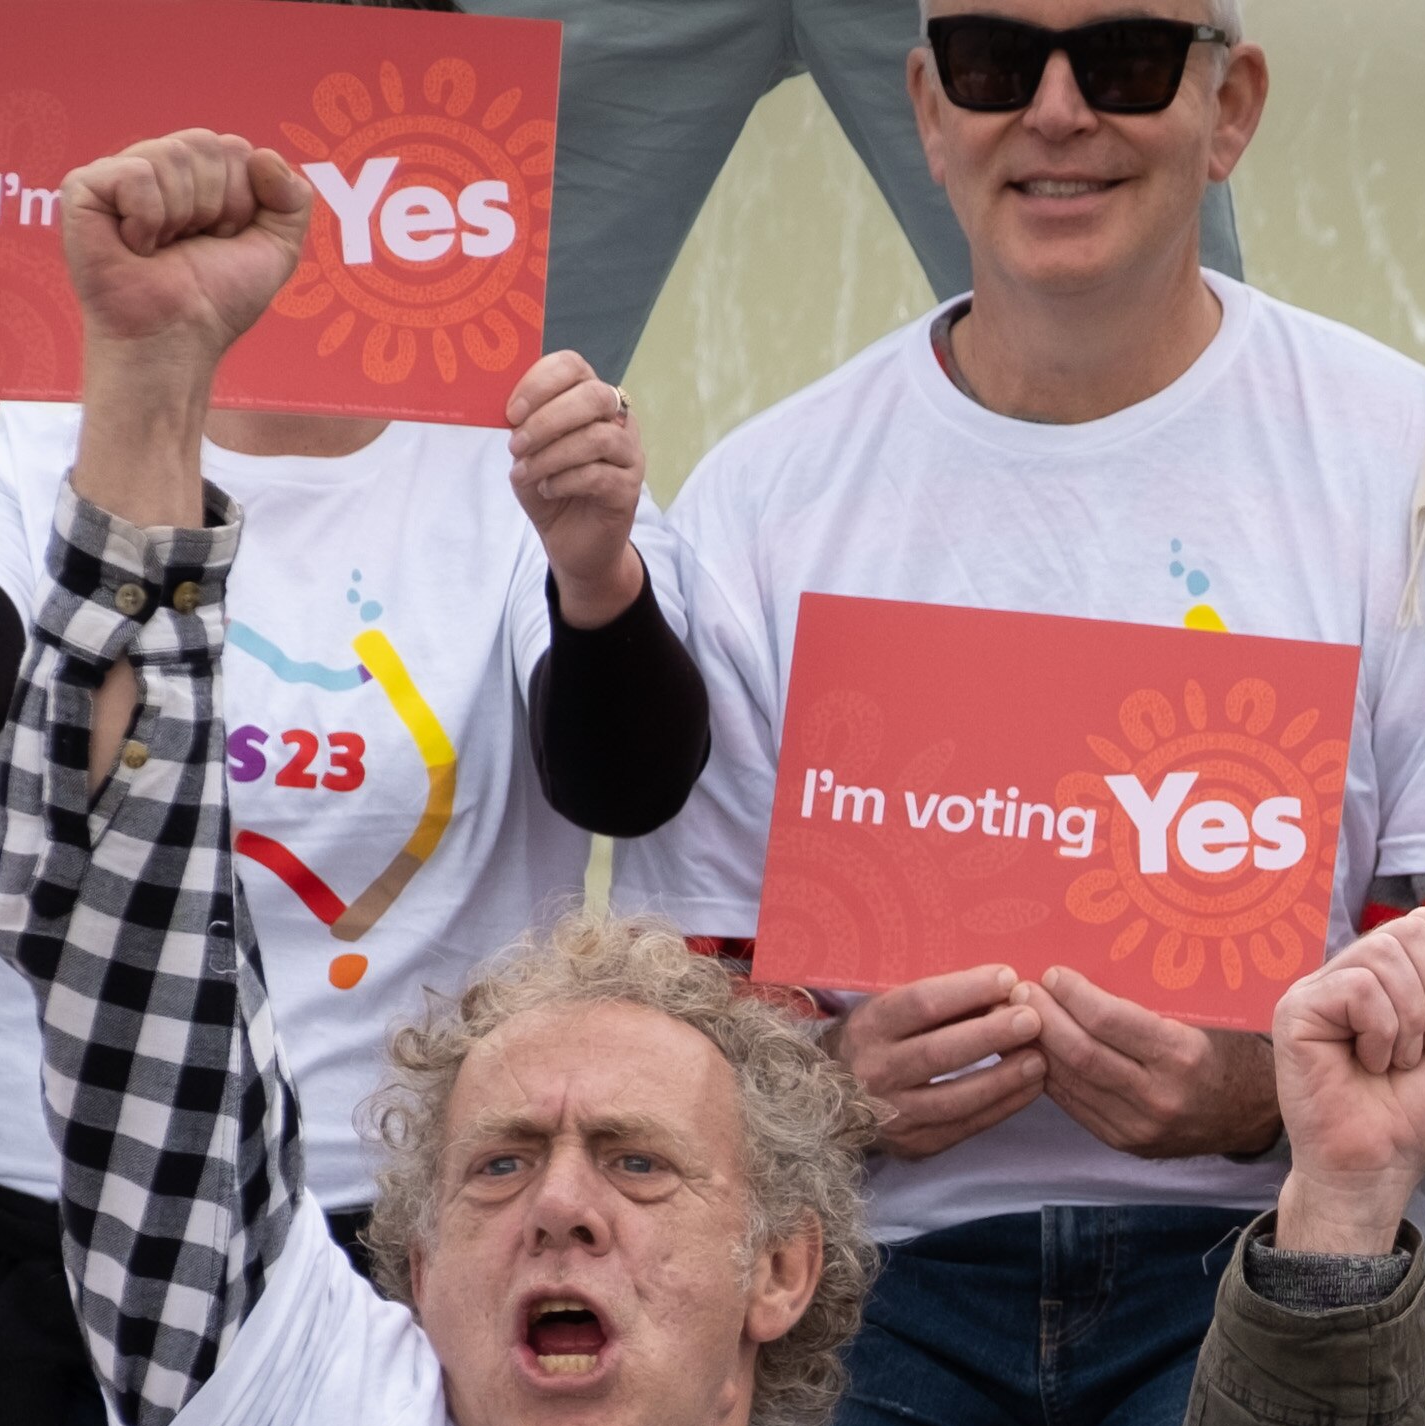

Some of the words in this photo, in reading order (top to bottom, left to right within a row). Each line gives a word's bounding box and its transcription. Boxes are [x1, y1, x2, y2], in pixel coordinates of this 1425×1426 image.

[301, 157, 516, 264] Yes
[801, 768, 886, 825] I'm
[904, 786, 1097, 859] voting
[1103, 771, 1307, 875] Yes
